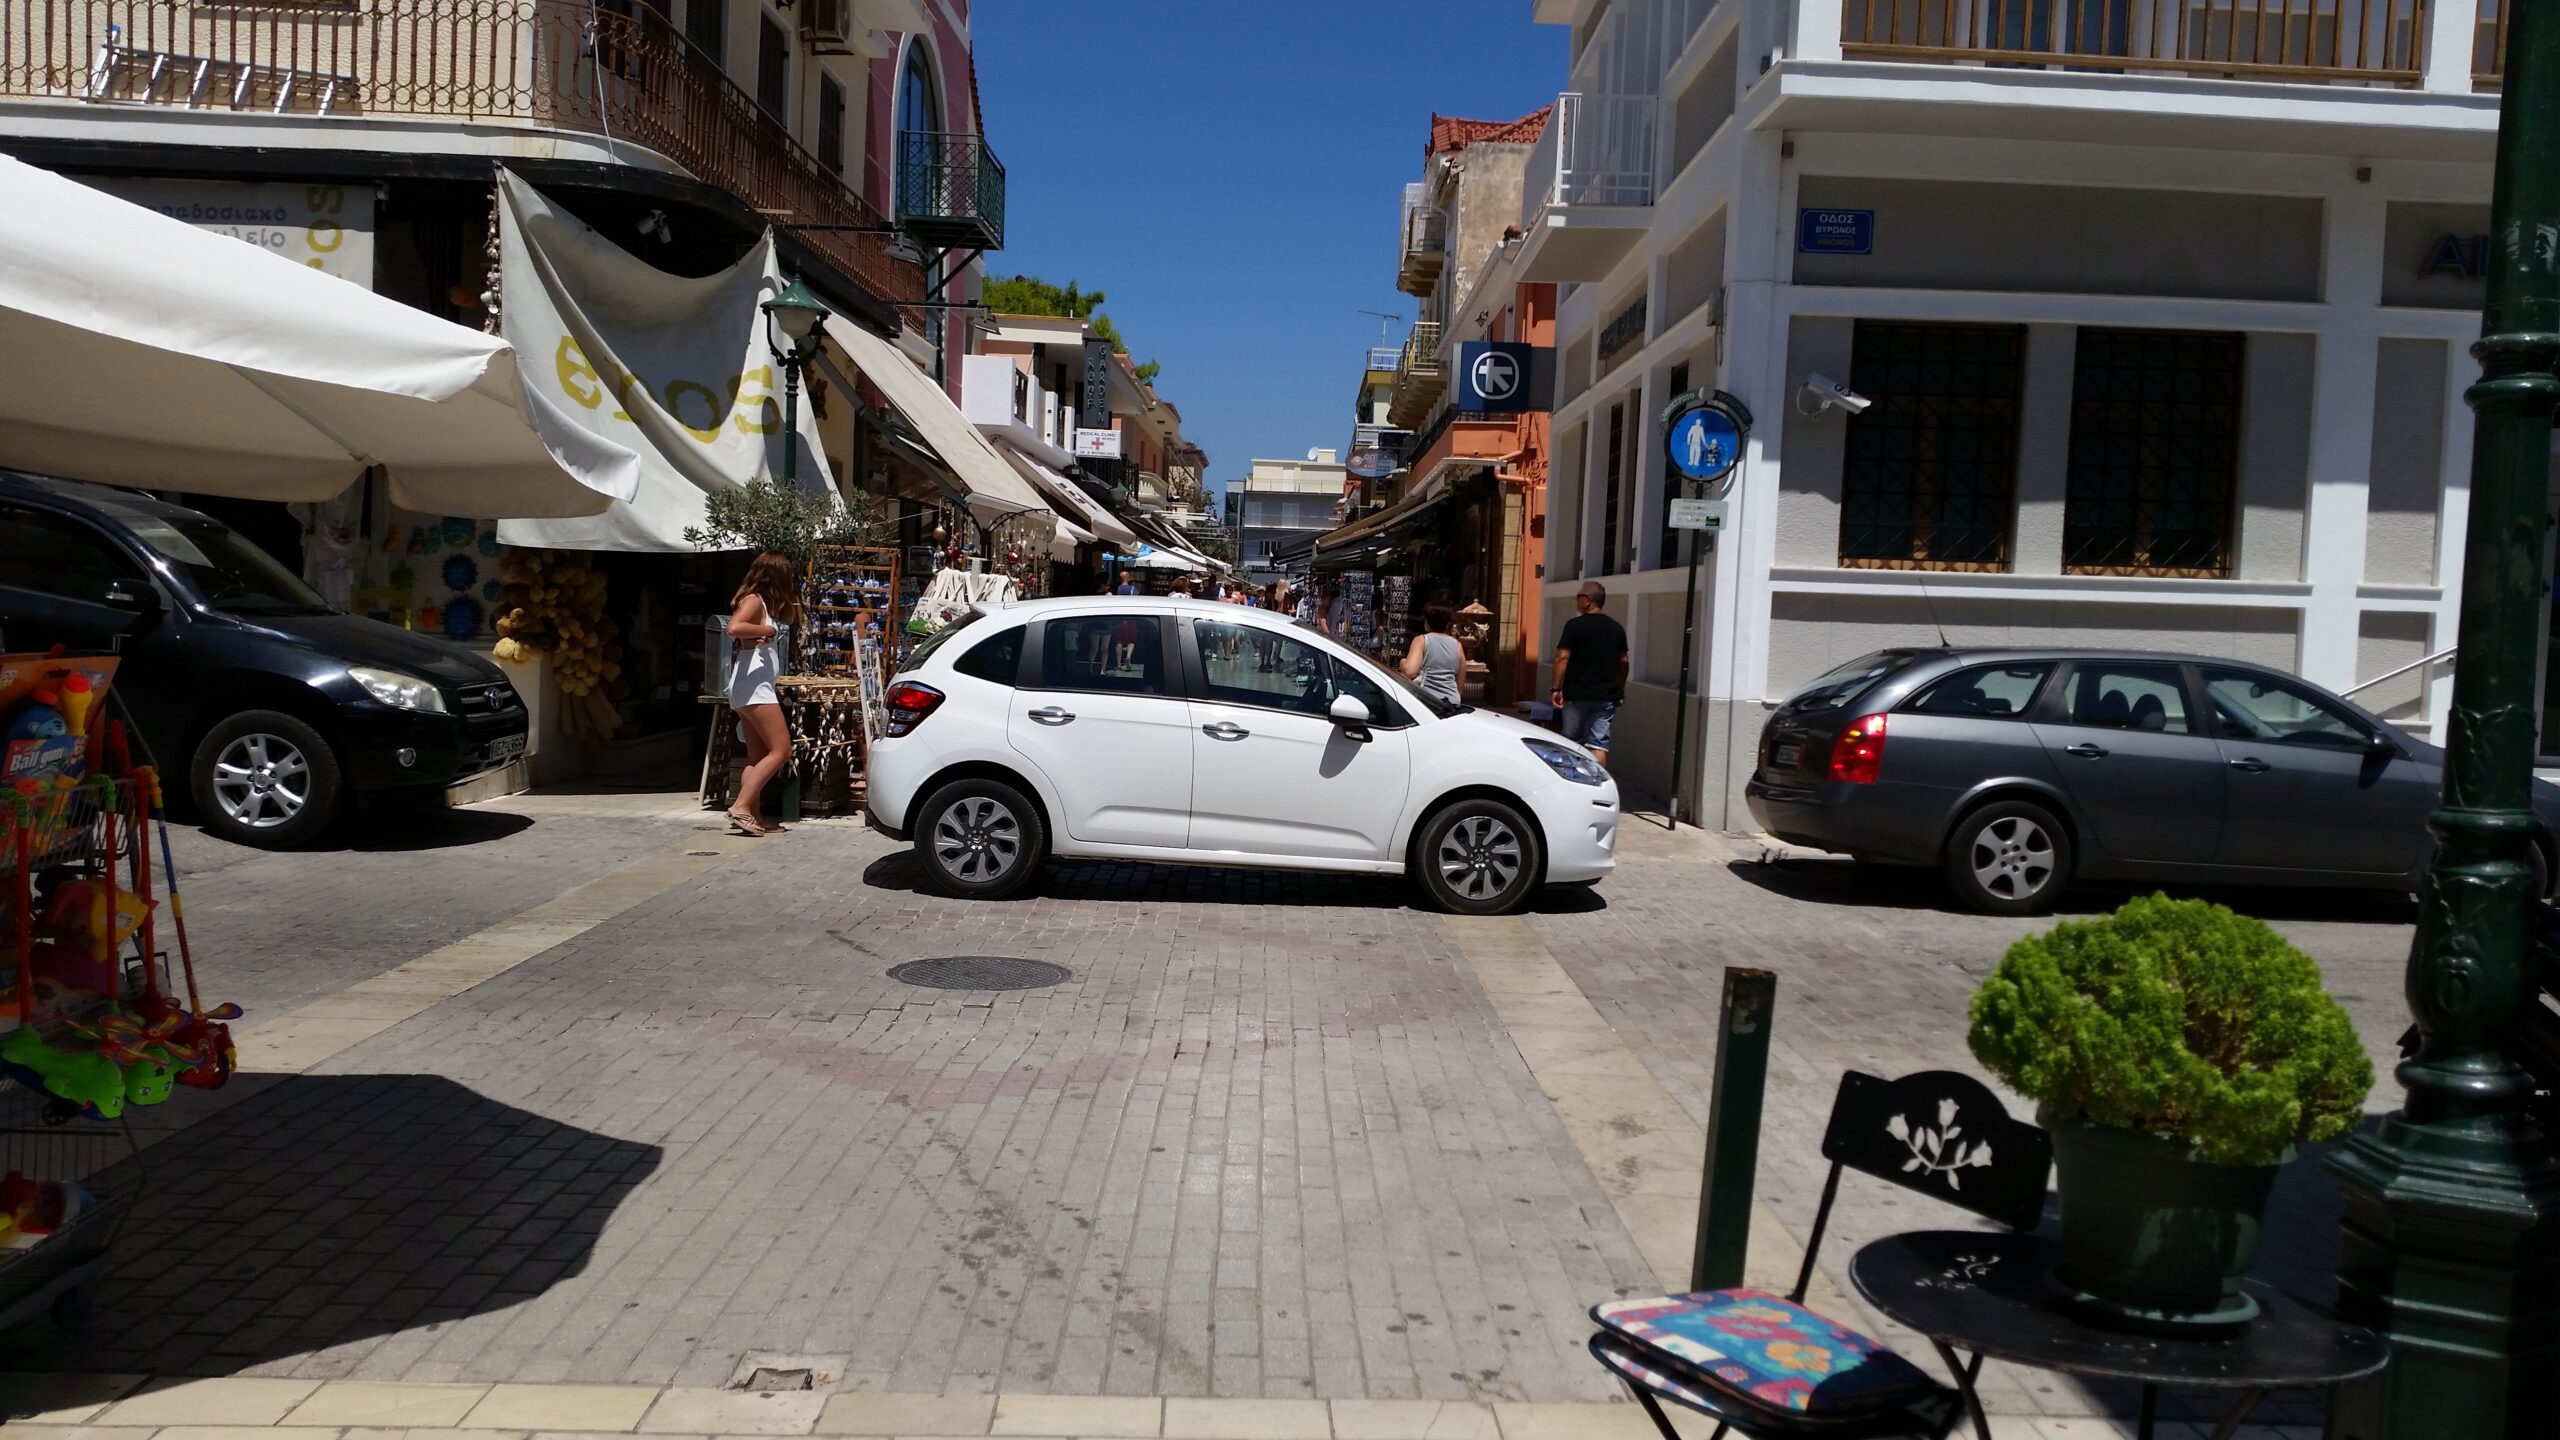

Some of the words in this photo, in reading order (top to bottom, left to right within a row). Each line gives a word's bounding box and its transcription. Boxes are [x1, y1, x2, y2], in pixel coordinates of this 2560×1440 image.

[1819, 213, 1855, 224] ΟΔΟΣ
[1815, 225, 1857, 235] ΒΥΡΩΝΟΣ
[1098, 344, 1107, 422] GARDEN
[9, 751, 40, 772] Ball
